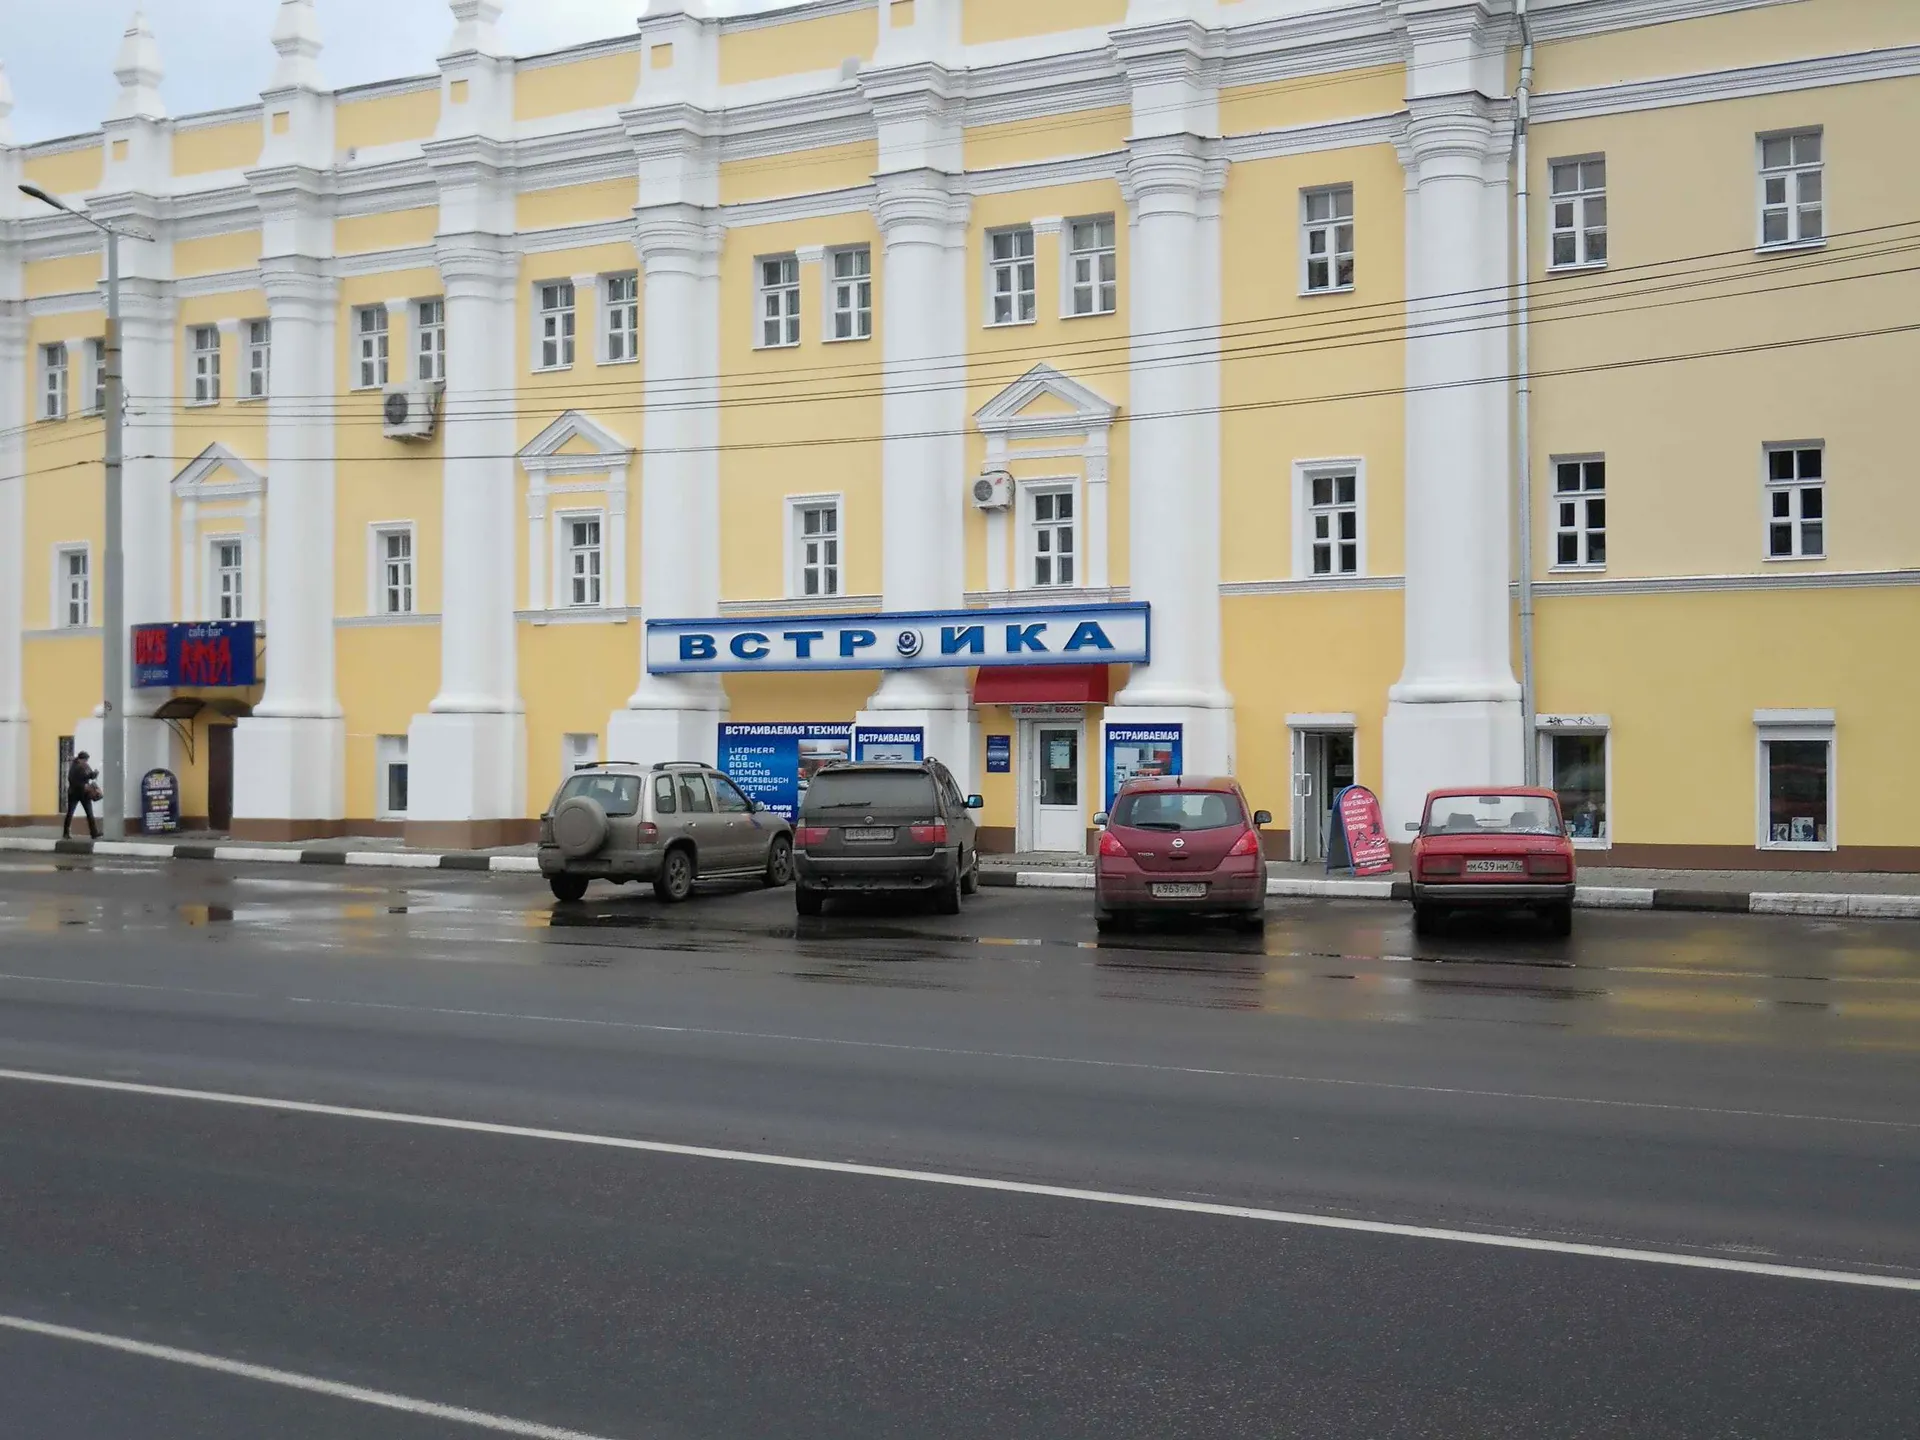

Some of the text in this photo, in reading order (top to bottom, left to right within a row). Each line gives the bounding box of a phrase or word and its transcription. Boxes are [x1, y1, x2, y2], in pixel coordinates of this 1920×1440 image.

[725, 725, 853, 735] ВСТРАИВАЕМАЯ ТЕХНИКА
[858, 733, 921, 742] ВСТРАИВАЕМАЯ
[1109, 731, 1180, 741] ВСТРАИВАЕМАЯ
